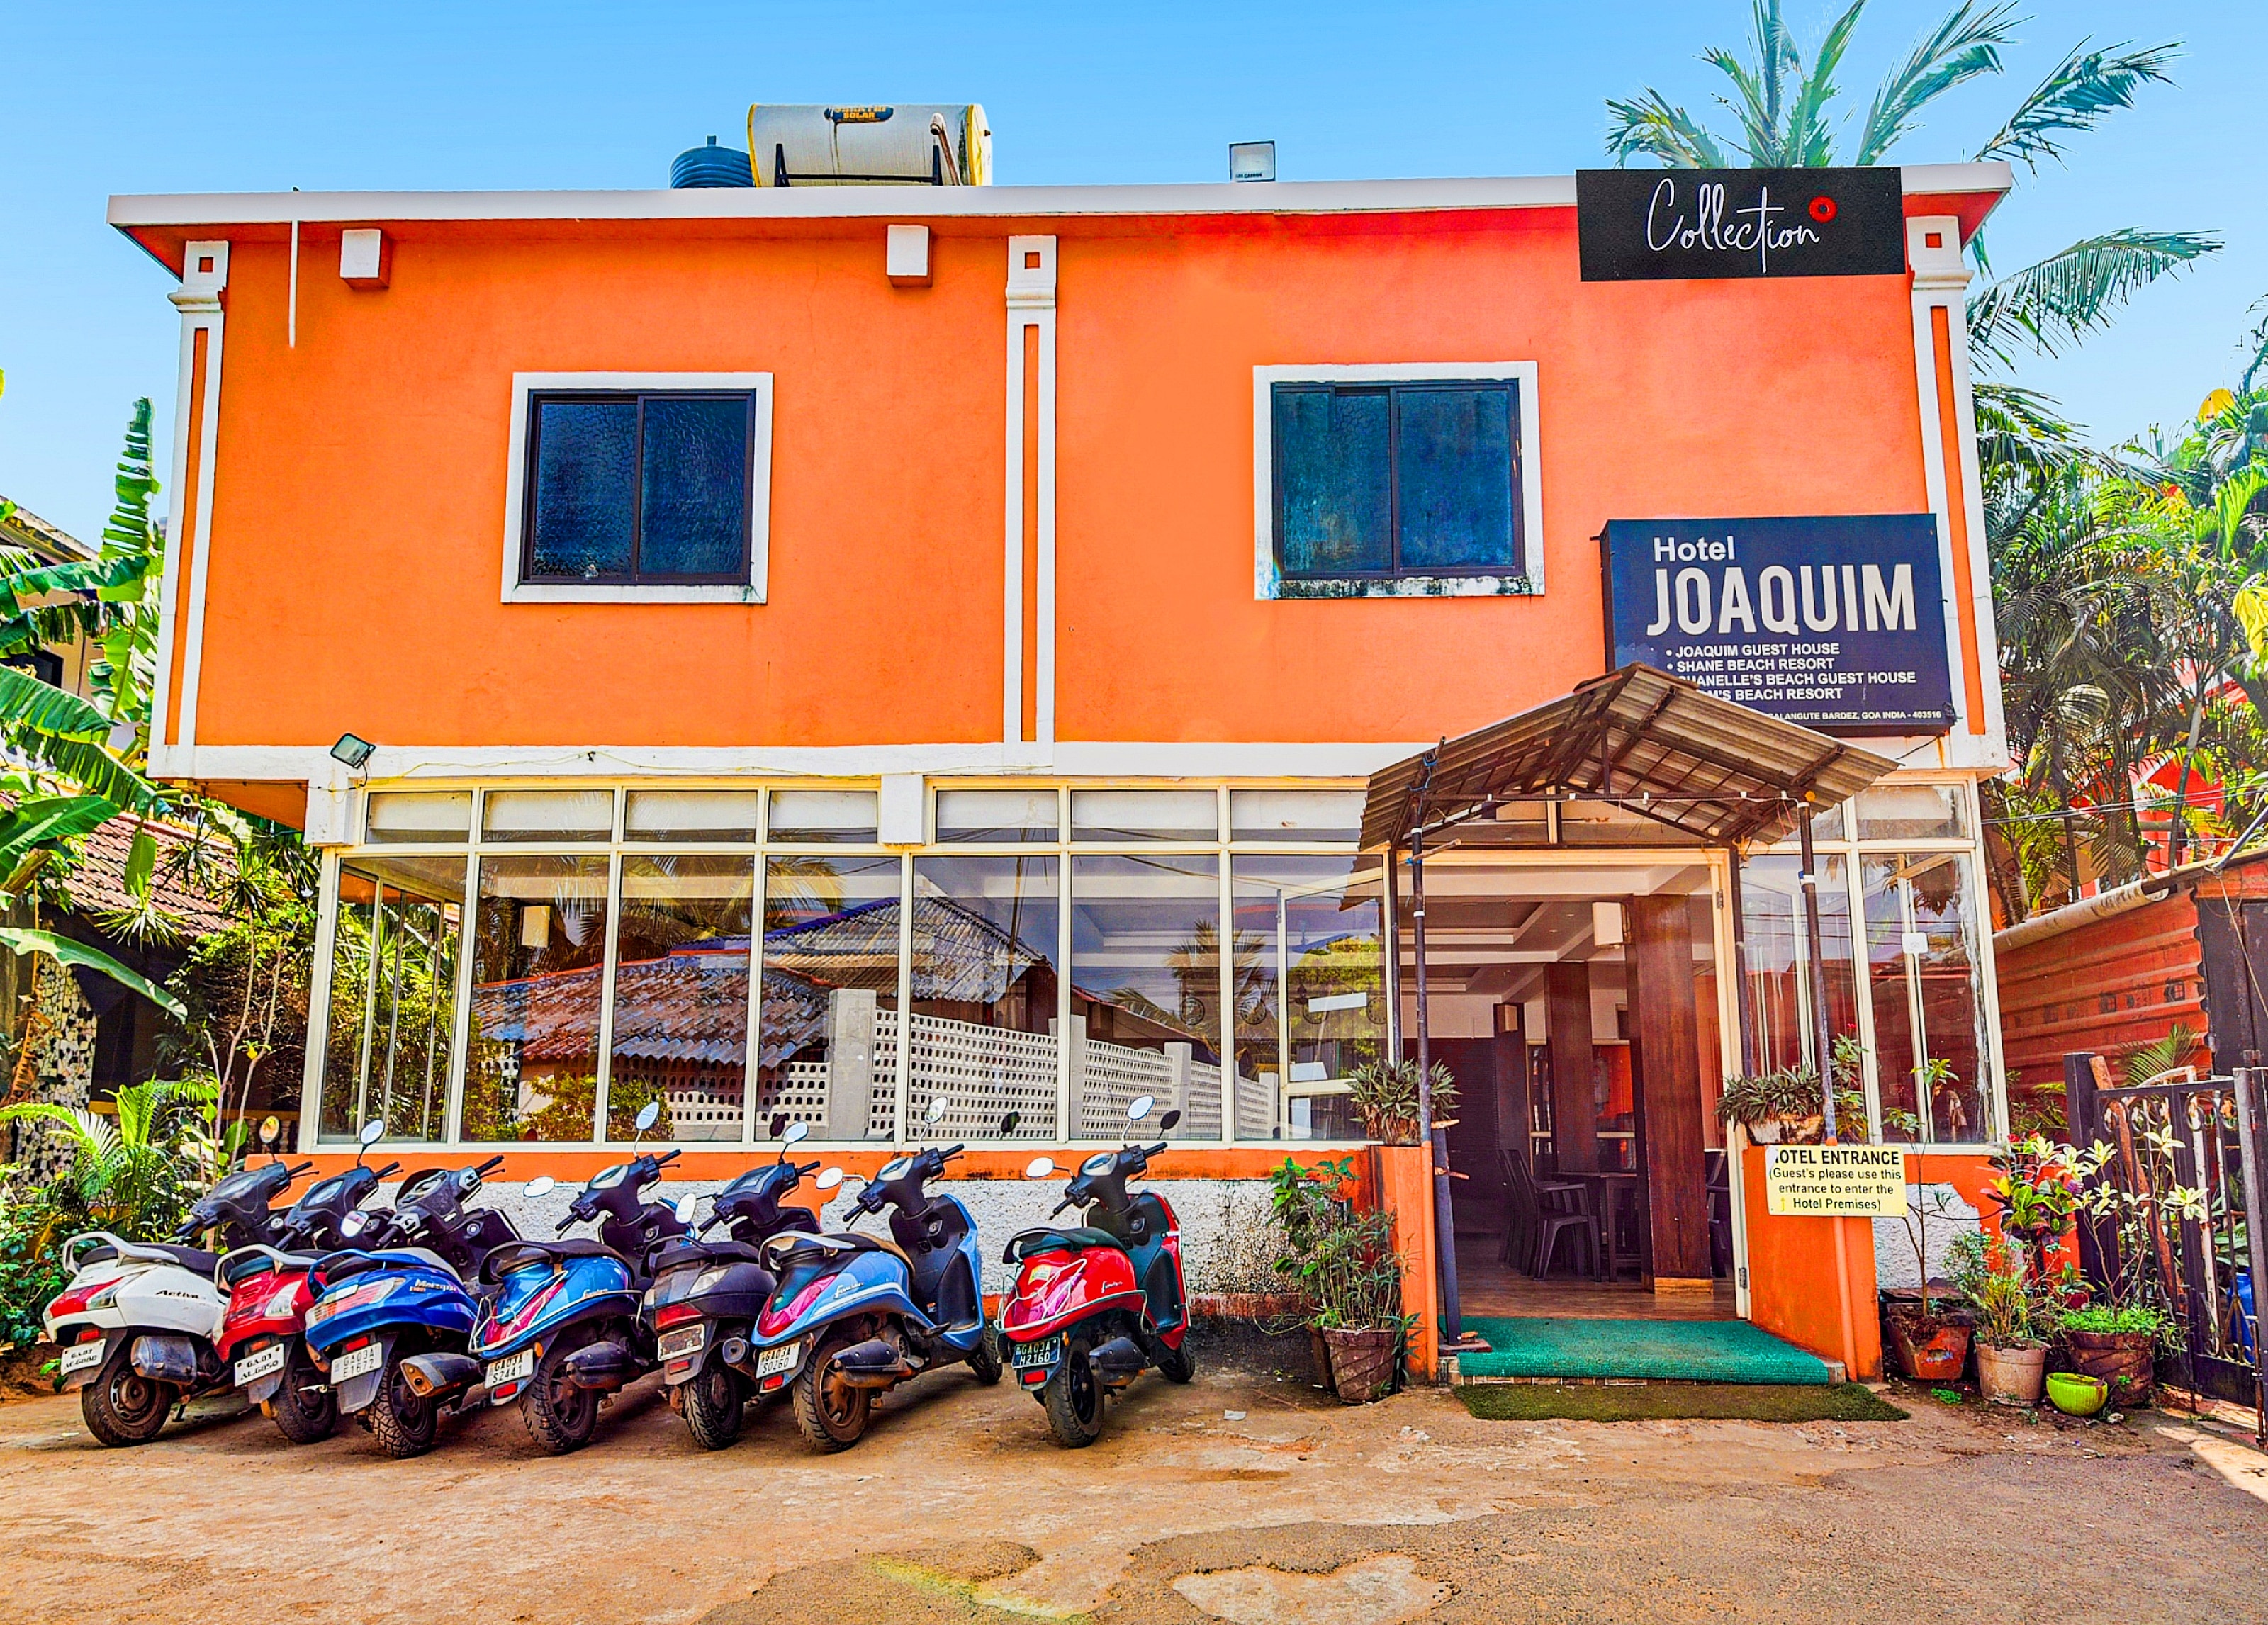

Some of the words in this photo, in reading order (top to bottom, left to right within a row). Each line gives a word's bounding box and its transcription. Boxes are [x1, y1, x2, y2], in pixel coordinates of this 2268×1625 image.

[1647, 177, 1820, 274] Collection
[1654, 536, 1735, 561] Hotel
[1646, 563, 1917, 636] JOAQUIM
[1675, 645, 1738, 658] JOAQUIM
[1741, 644, 1788, 656] GUEST
[1792, 643, 1840, 656] HOUSE
[1677, 660, 1724, 673] SHANE
[1727, 658, 1775, 671] BEACH
[1779, 658, 1834, 670] RESORT
[1766, 673, 1814, 685] BEACH
[1817, 672, 1864, 685] GUEST
[1868, 671, 1916, 684] HOUSE
[1735, 688, 1783, 701] BEACH
[1787, 687, 1843, 700] RESORT
[1822, 712, 1860, 720] BARDEZ,
[1912, 710, 1941, 719] 403516
[1775, 1149, 1817, 1164] OTEL
[1821, 1150, 1899, 1165] ENTRANCE
[1769, 1167, 1815, 1180] (Guest's
[1819, 1169, 1854, 1181] please
[1858, 1171, 1877, 1179] use
[1881, 1169, 1902, 1179] this
[1779, 1184, 1827, 1193] entrance
[1831, 1184, 1841, 1194] to
[1845, 1185, 1873, 1194] enter
[1876, 1184, 1894, 1194] the
[1793, 1198, 1822, 1208] Hotel
[1826, 1198, 1881, 1211] Premises)
[1020, 1351, 1050, 1366] H2160
[493, 1364, 522, 1383] S2441
